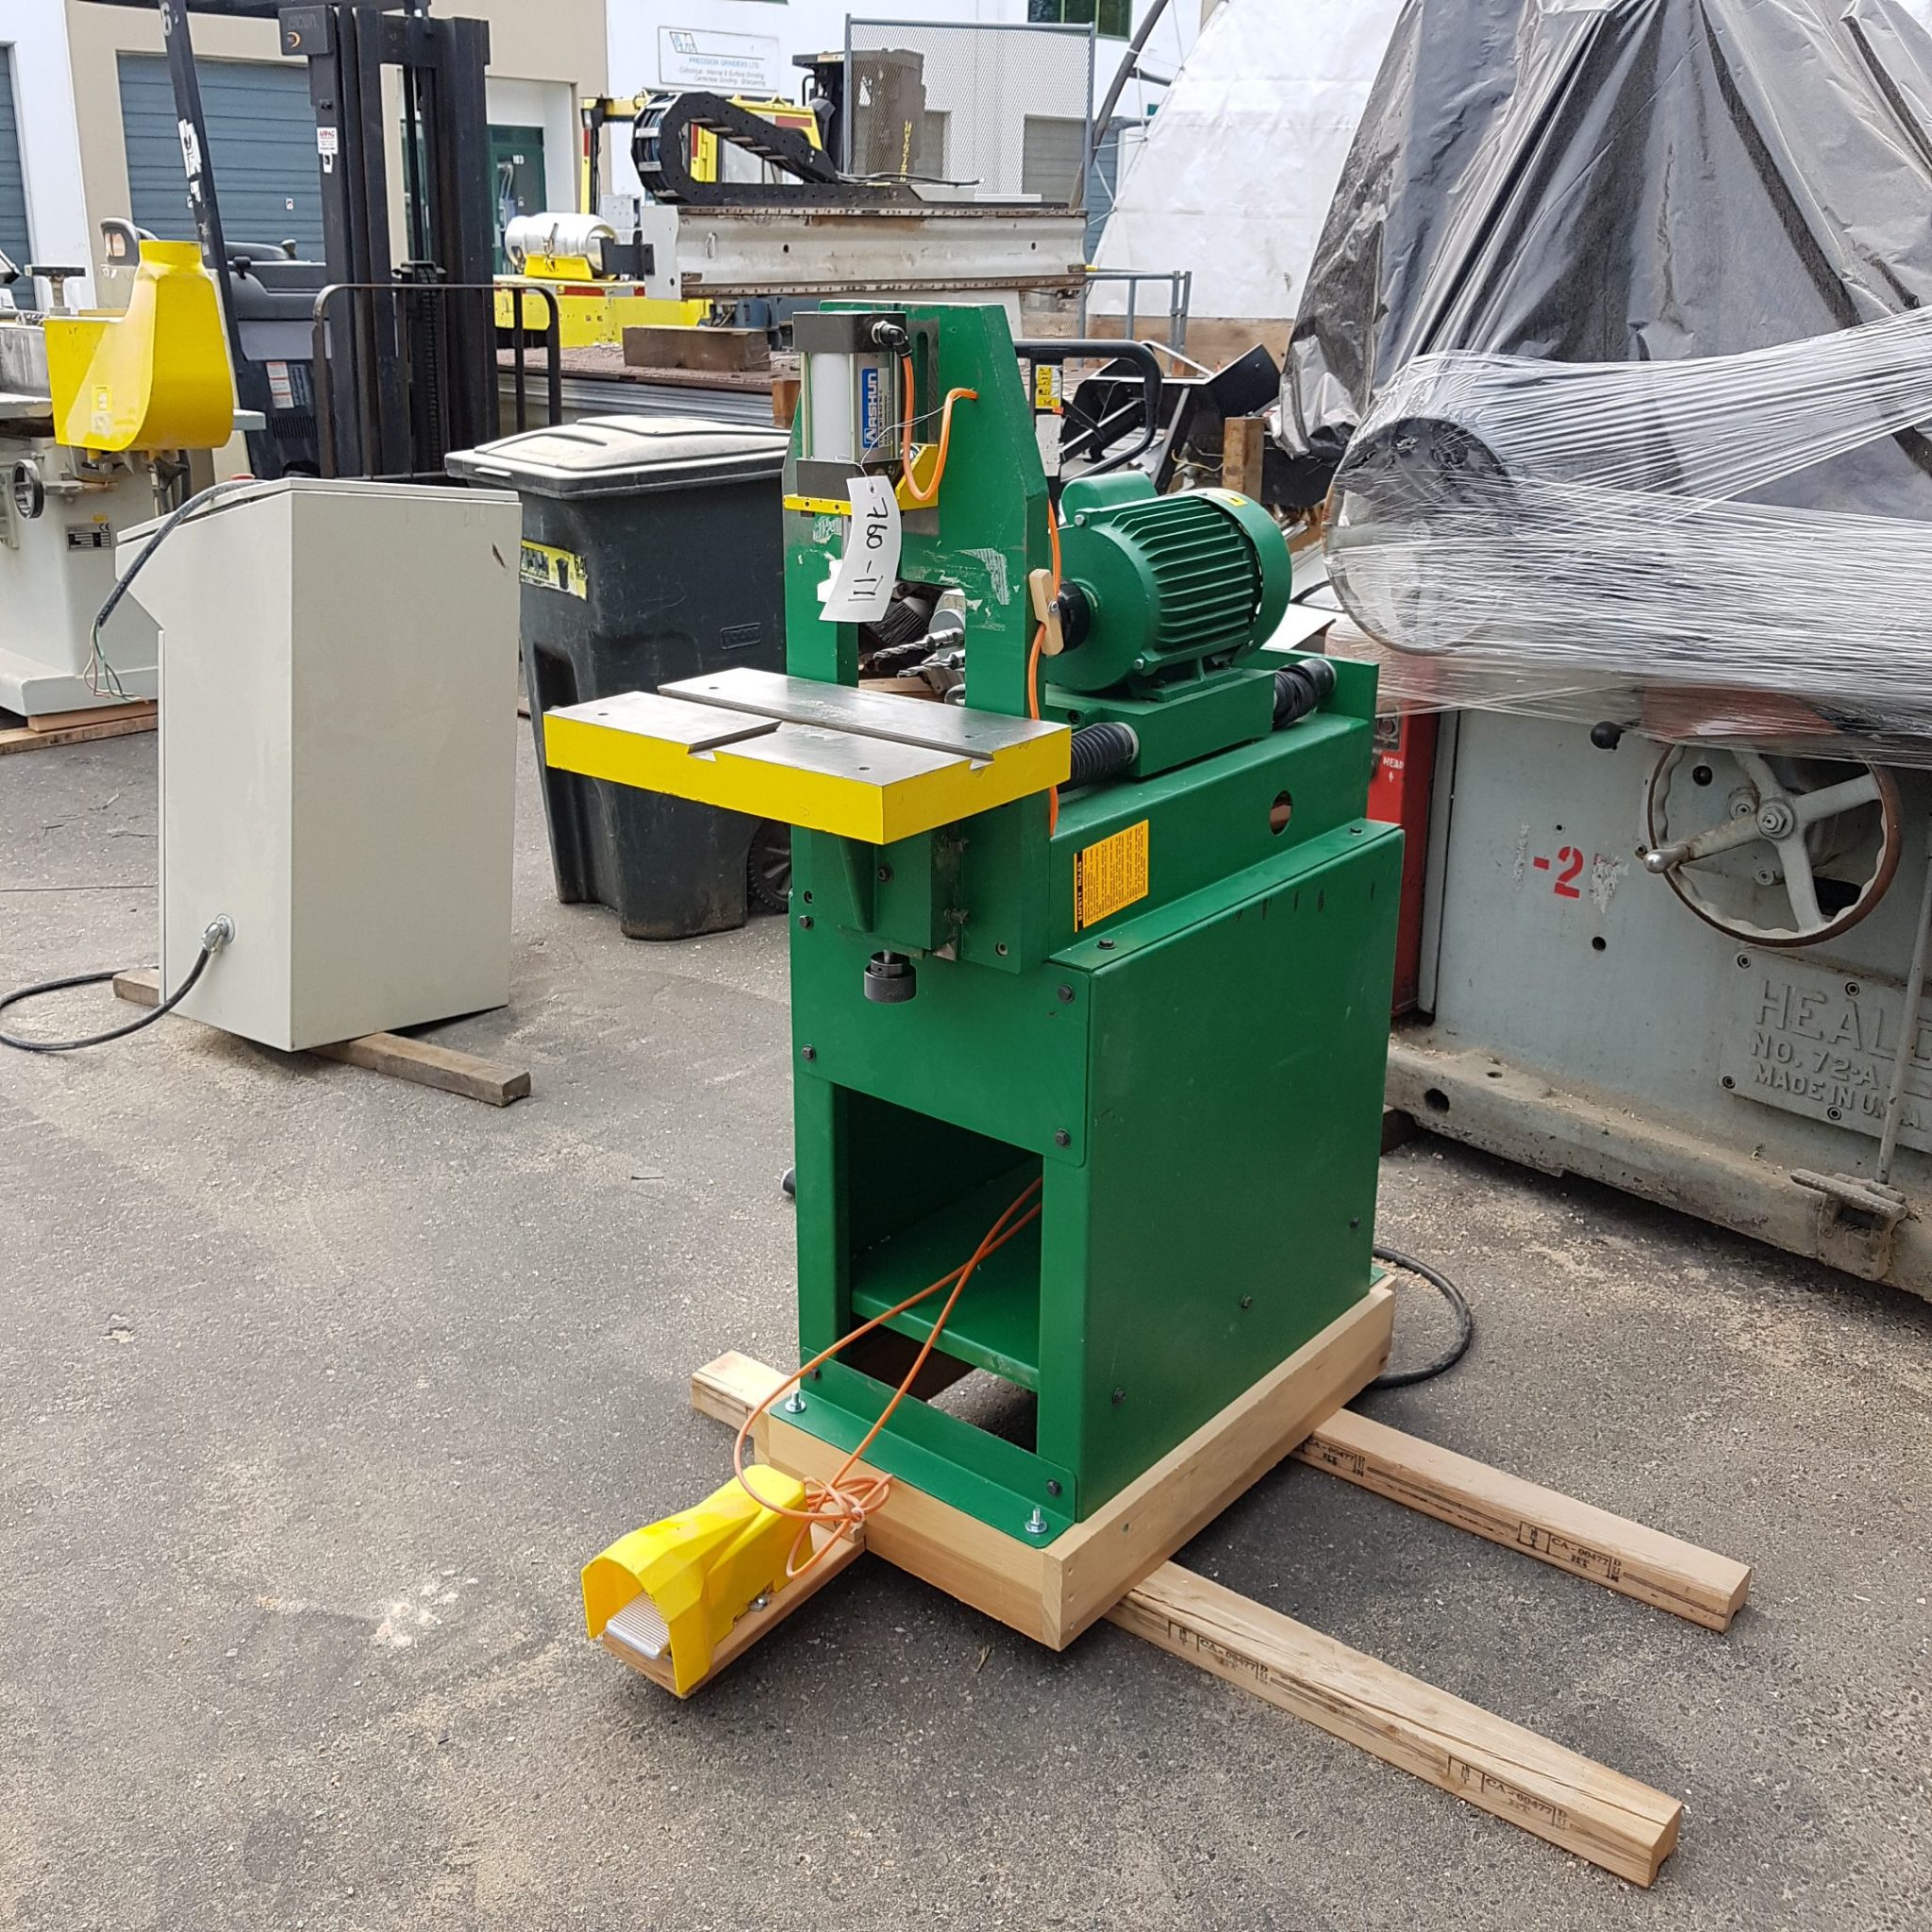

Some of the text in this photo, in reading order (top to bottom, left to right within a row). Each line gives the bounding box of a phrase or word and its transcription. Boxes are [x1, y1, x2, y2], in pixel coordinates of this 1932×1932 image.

[1382, 756, 1405, 770] HEAD
[1753, 1063, 1826, 1102] MADE
[1827, 1084, 1857, 1110] IN
